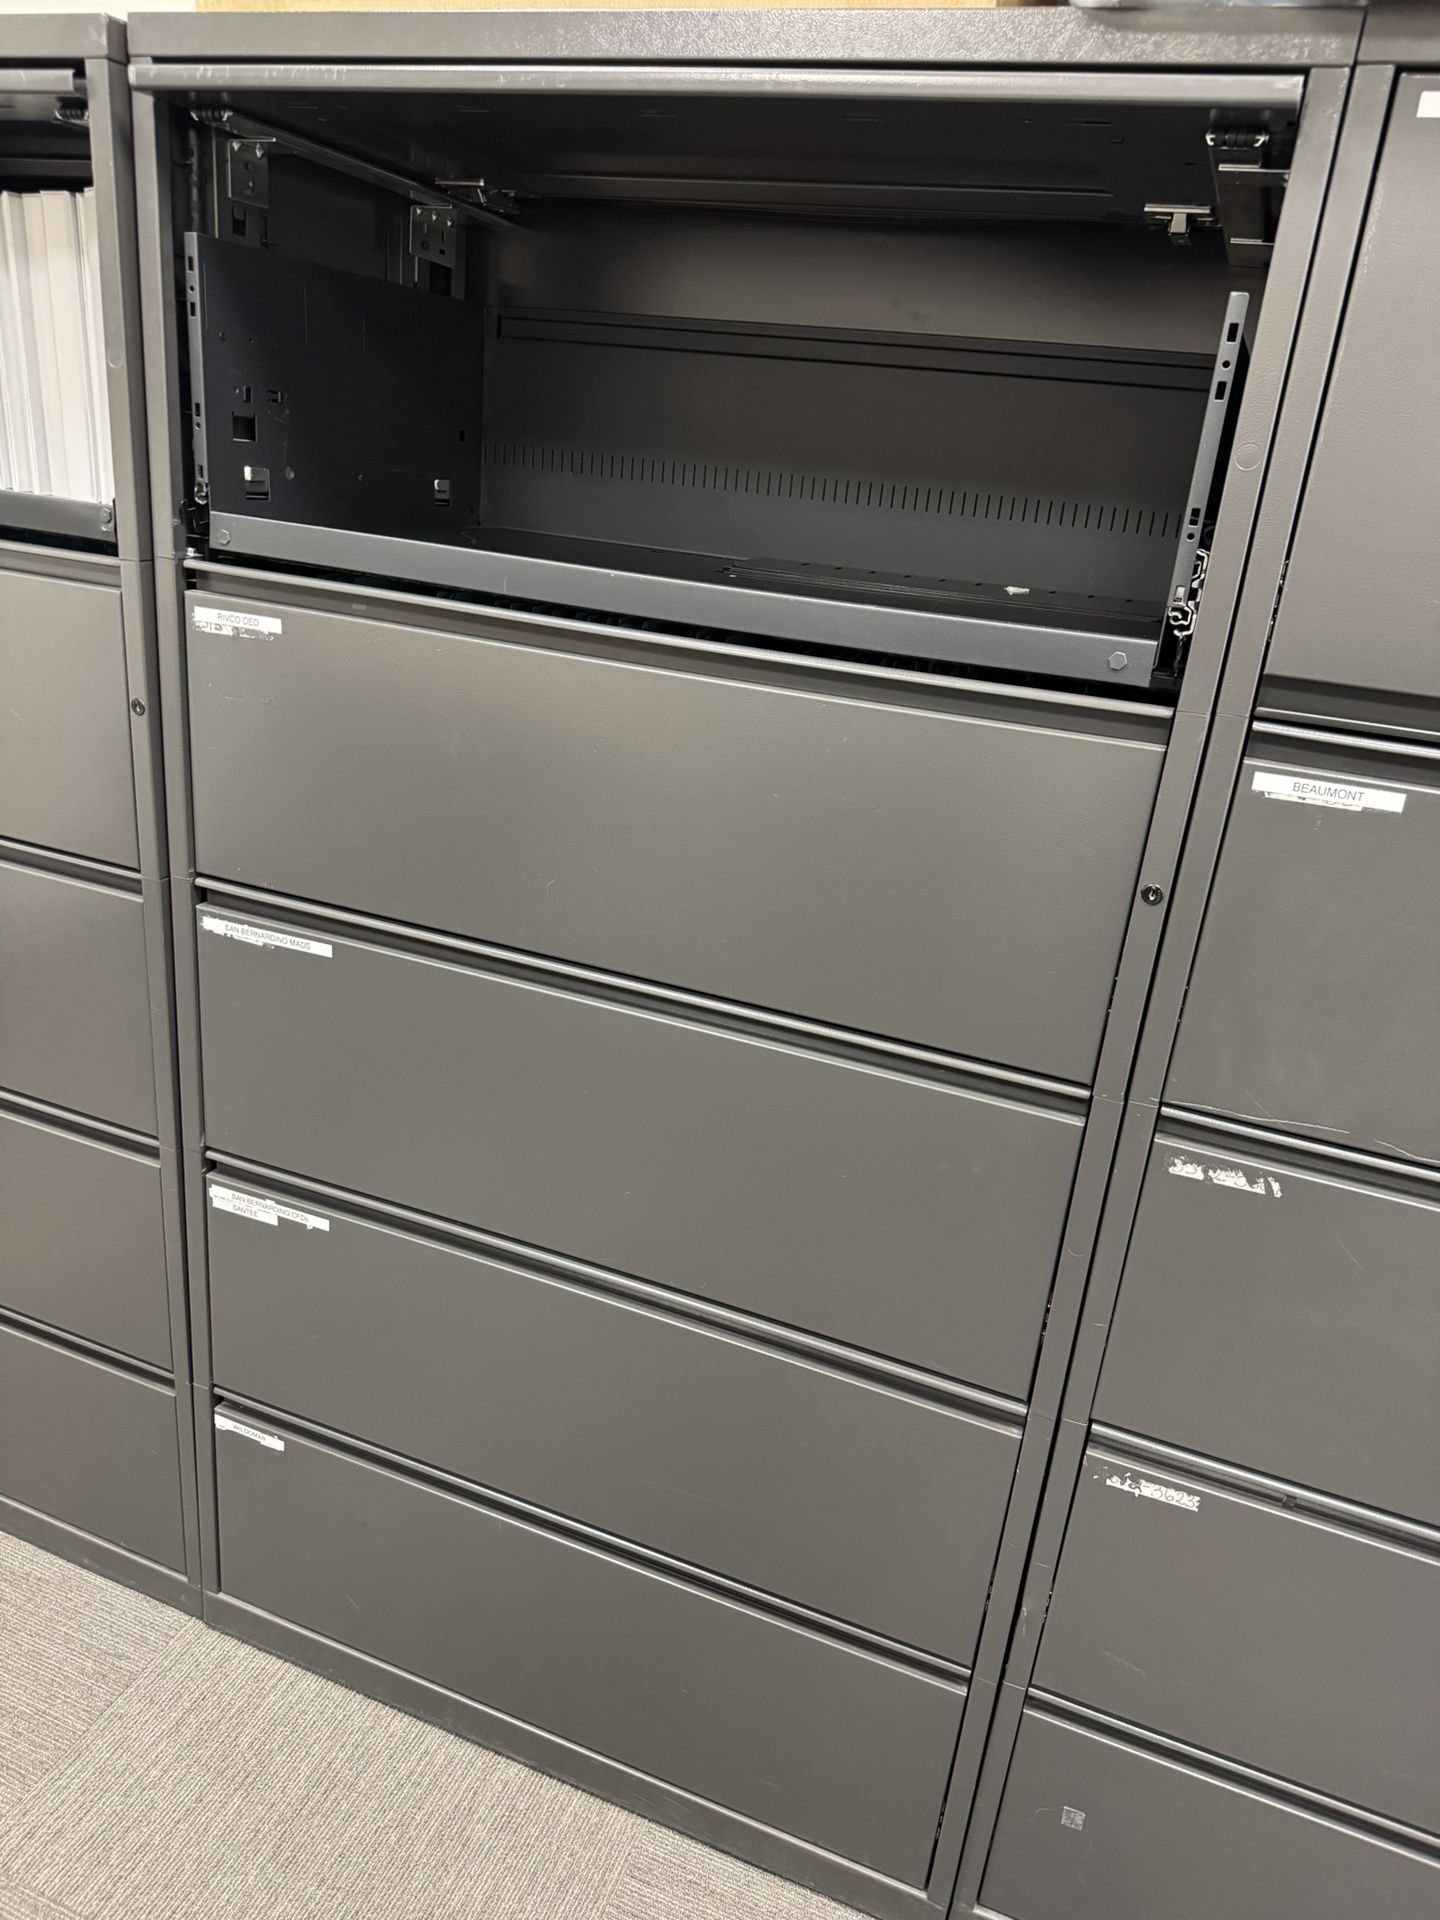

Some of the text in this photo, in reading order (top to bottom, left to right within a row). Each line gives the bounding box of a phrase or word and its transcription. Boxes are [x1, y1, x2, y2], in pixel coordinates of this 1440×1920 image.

[217, 612, 240, 624] RIVCO
[1292, 781, 1366, 802] BEAUMONT
[224, 923, 240, 934] SAN
[241, 927, 288, 945] BERNARDINO
[231, 1193, 246, 1203] SAN
[246, 1196, 291, 1217] BERNARDINO
[232, 1204, 258, 1218] SANTEE
